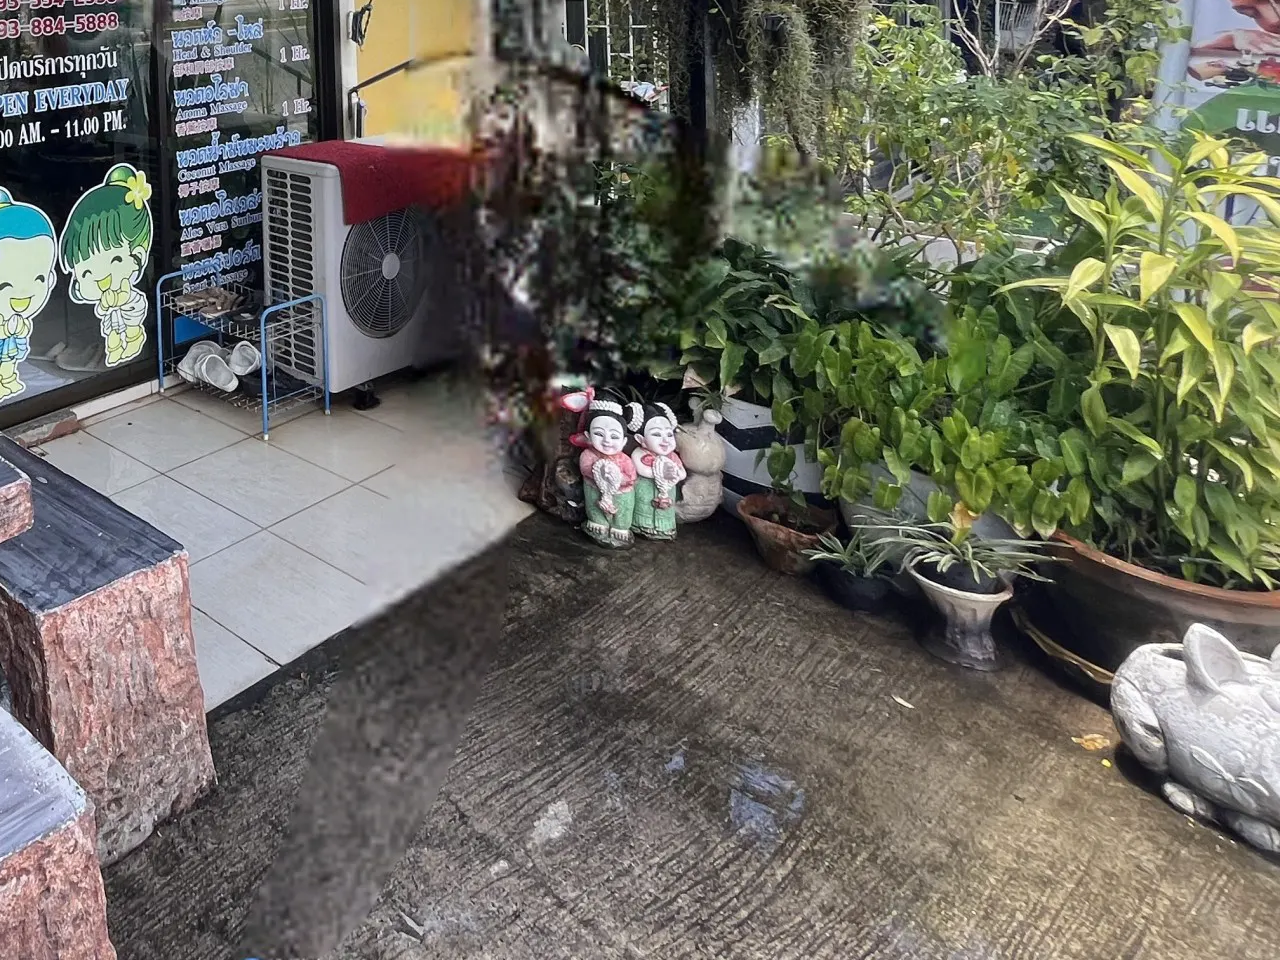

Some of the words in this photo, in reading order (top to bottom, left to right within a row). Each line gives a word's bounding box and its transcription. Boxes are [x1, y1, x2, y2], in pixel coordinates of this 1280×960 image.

[172, 48, 198, 62] Head
[200, 46, 211, 58] &
[213, 42, 252, 57] Shoulder
[279, 47, 287, 63] 1
[291, 45, 310, 62] Hr.
[34, 78, 130, 113] EVERYDAY
[175, 106, 208, 121] Aroma
[210, 100, 248, 116] Massage
[282, 100, 289, 116] 1
[294, 98, 312, 115] Hr.
[18, 121, 46, 146] AM.
[64, 116, 100, 139] 11.00
[103, 109, 127, 133] PM.
[178, 165, 217, 182] Coconut
[218, 158, 257, 174] Massage
[180, 227, 204, 241] Aloe
[206, 221, 229, 235] Vera
